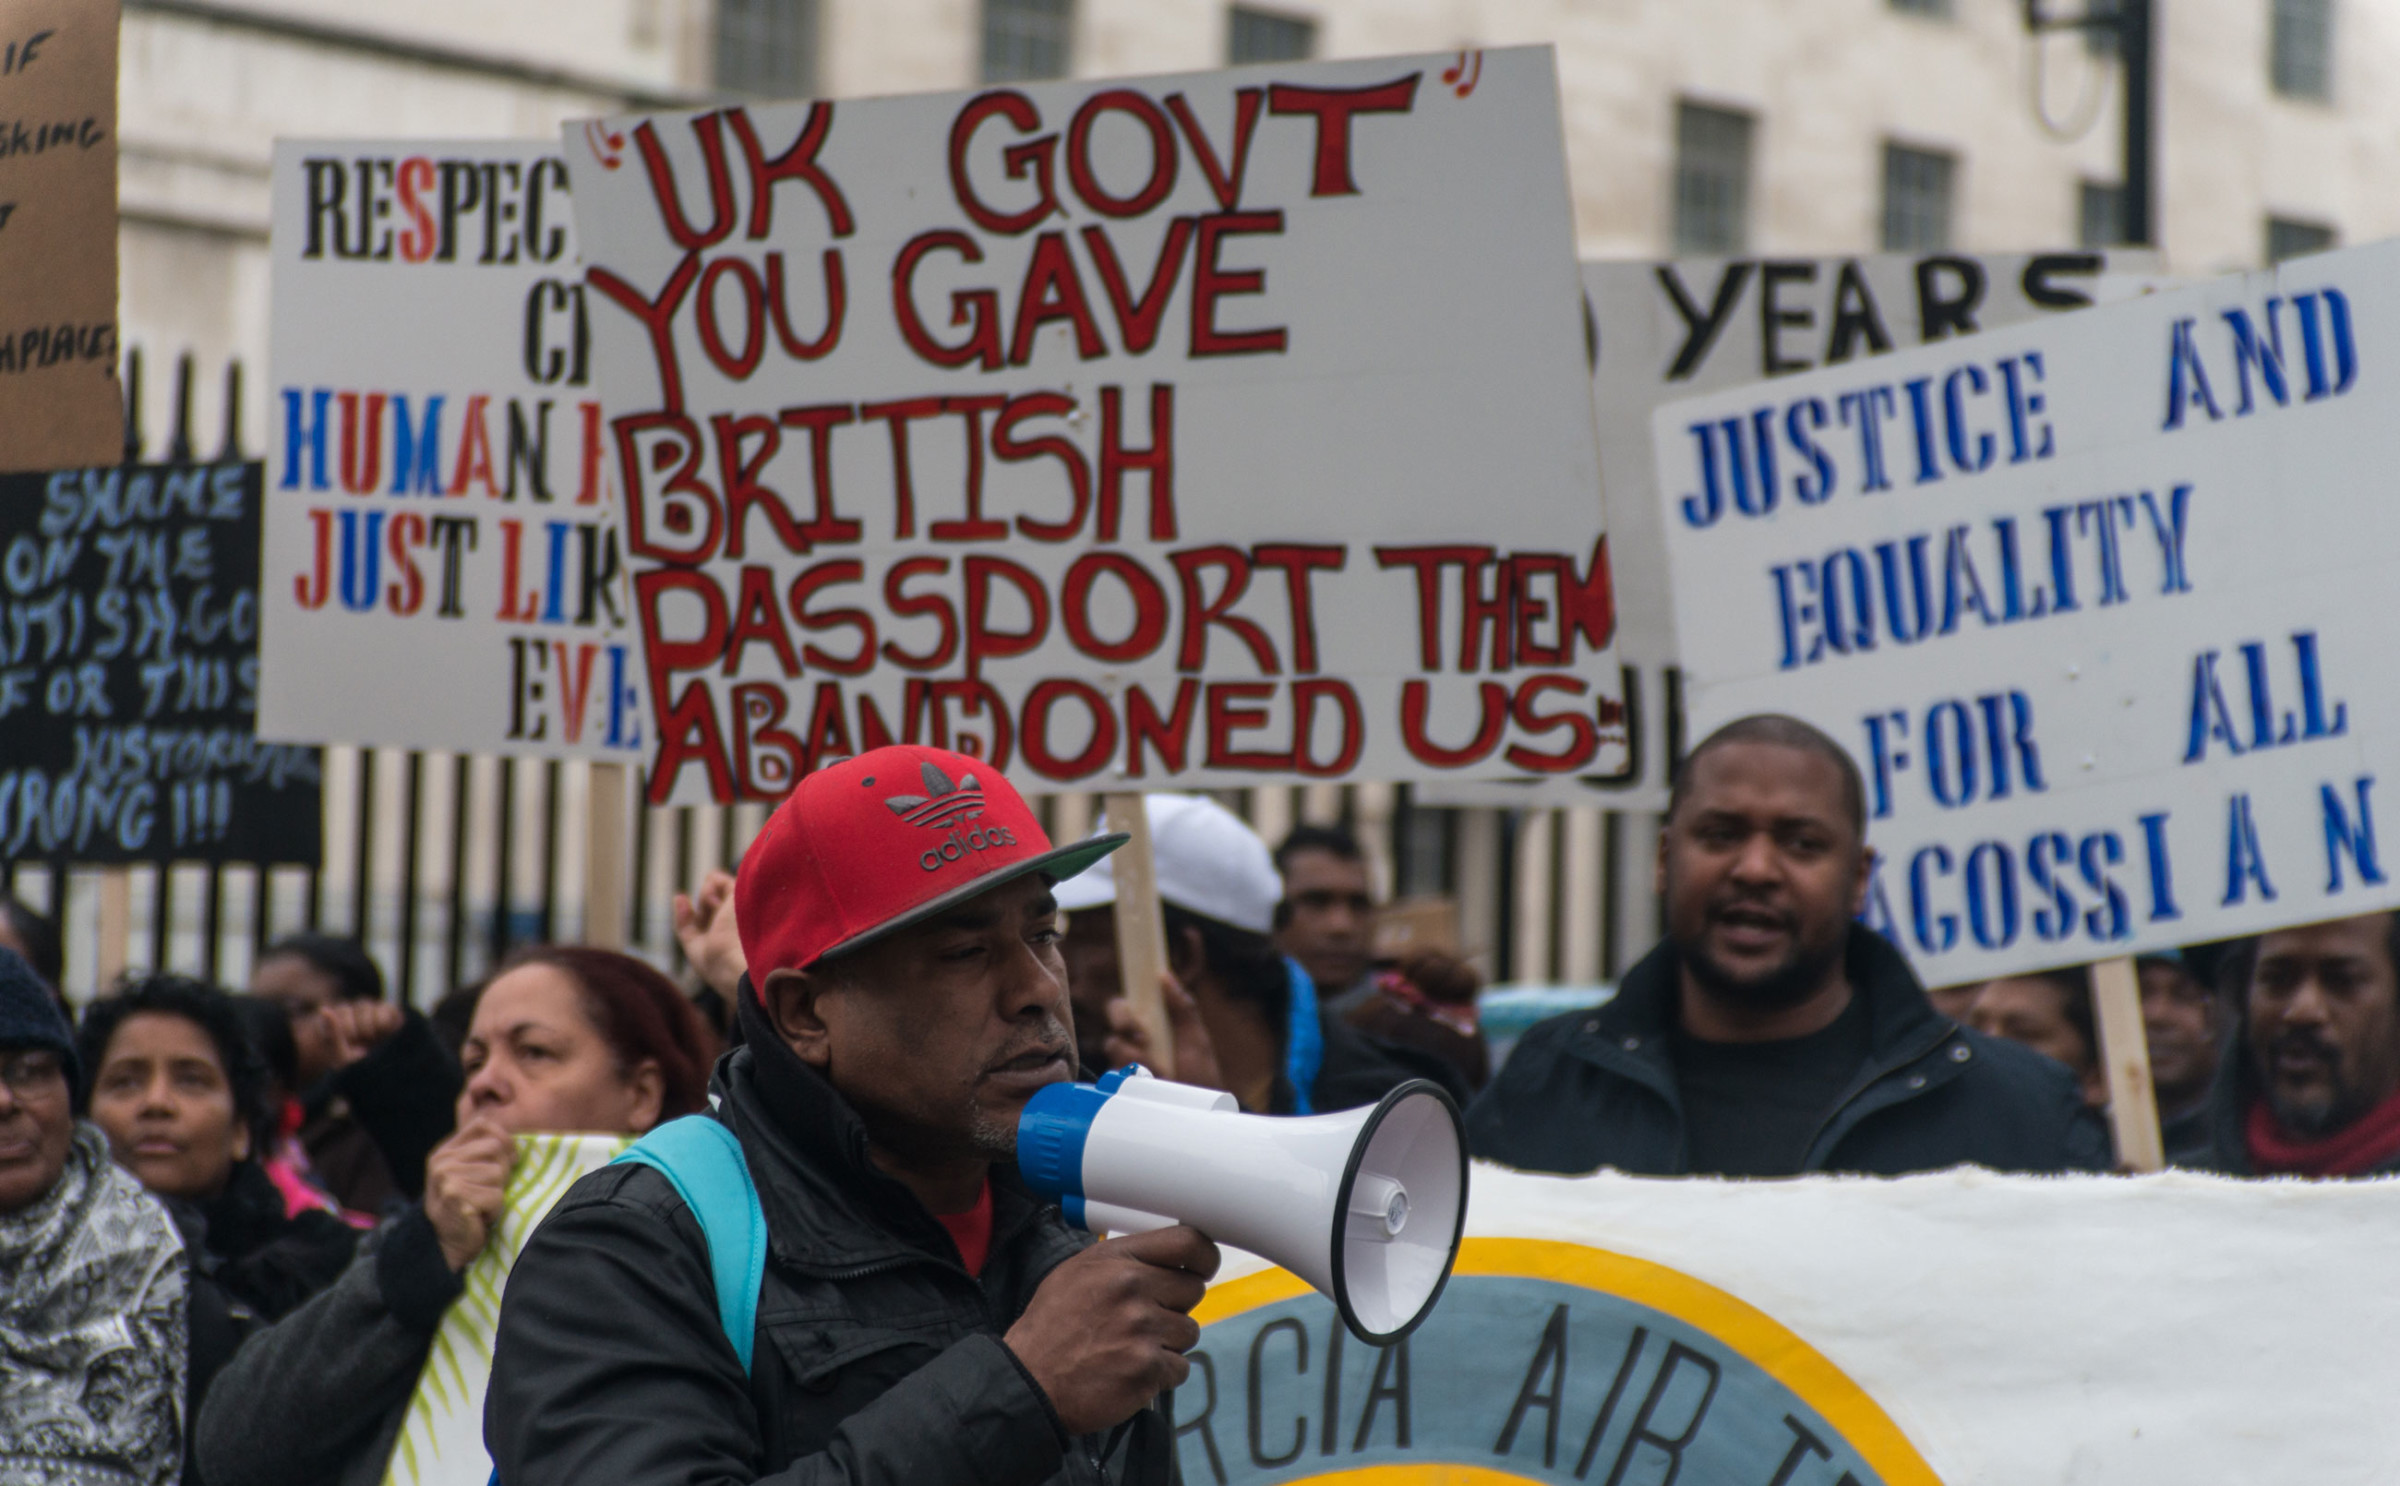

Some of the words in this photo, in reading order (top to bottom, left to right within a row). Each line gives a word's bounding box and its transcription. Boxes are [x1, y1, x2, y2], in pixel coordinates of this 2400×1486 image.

[4, 28, 56, 75] IF
[633, 100, 855, 250] UK
[948, 71, 1423, 236] GOVT
[585, 248, 847, 412] YOU
[892, 208, 1288, 372] GAVE
[1653, 252, 2105, 382] YEARS
[279, 388, 554, 503] HUMAN
[611, 384, 1178, 564] BRITISH
[1681, 351, 2055, 529] JUSTICE
[2161, 286, 2360, 432] AND
[4, 534, 82, 596] ON
[95, 527, 213, 588] THE
[39, 467, 246, 536] SHAME
[294, 508, 478, 620] JUST
[1770, 484, 2194, 671] EQUALITY
[0, 665, 113, 720] FOR
[634, 544, 1346, 728] PASSPORT
[1863, 689, 2048, 820] FOR
[2181, 630, 2349, 765] ALL
[919, 824, 1017, 872] adidas
[1494, 1303, 1722, 1486] AIR
